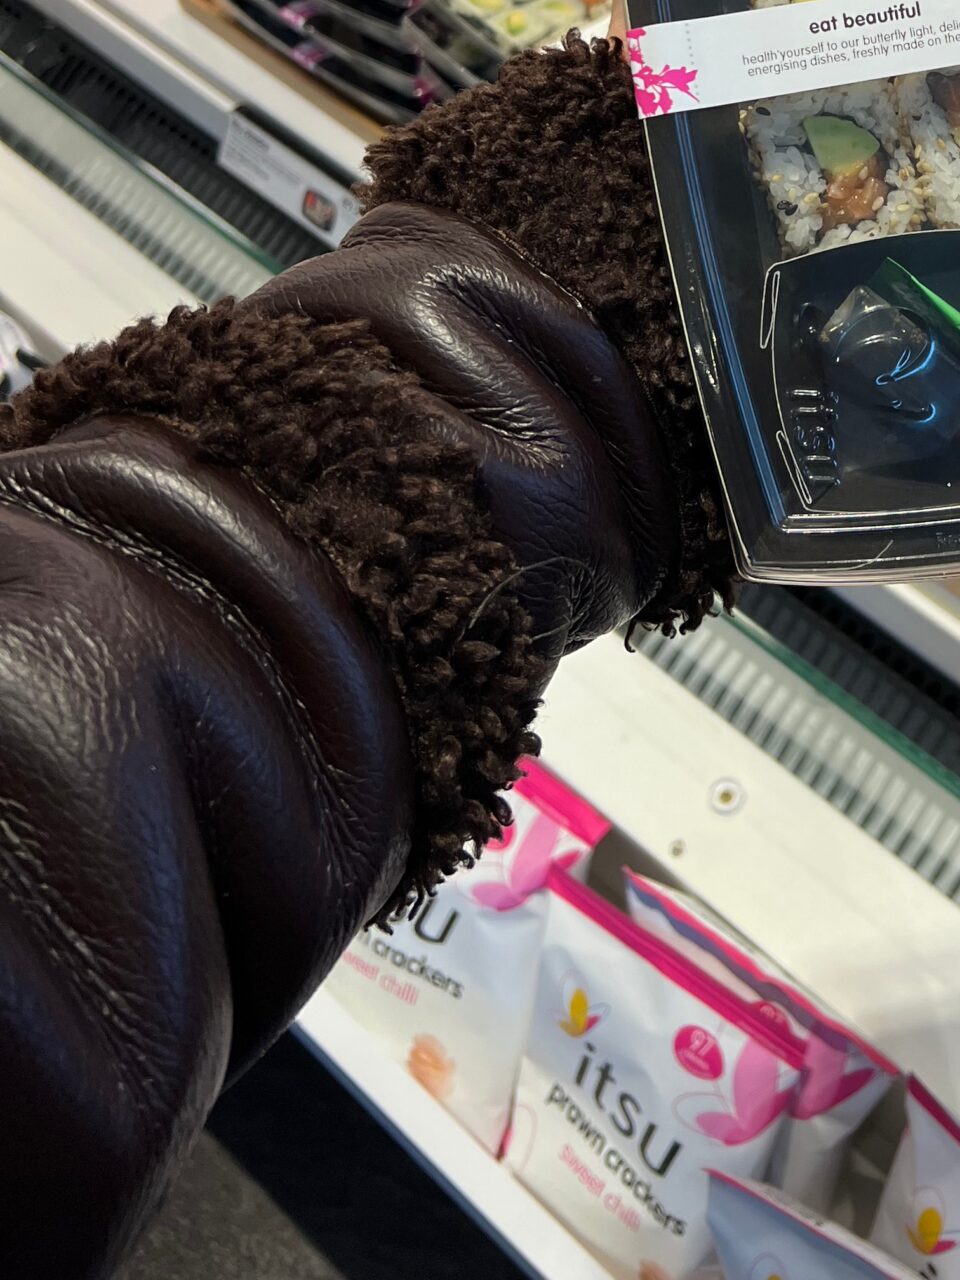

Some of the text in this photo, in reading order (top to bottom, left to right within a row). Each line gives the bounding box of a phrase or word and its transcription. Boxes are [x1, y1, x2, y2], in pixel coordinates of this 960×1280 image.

[809, 1, 921, 34] eat beautiful
[827, 41, 838, 51] to
[841, 38, 860, 49] our
[863, 29, 906, 46] butterfly
[909, 25, 937, 40] light,
[747, 58, 807, 77] energising
[810, 53, 850, 67] dishes,
[852, 45, 889, 59] freshly
[892, 39, 925, 53] made
[927, 37, 941, 47] on
[372, 937, 464, 999] crackers
[576, 1041, 682, 1180] itsu
[546, 1083, 688, 1236] prawn crackers
